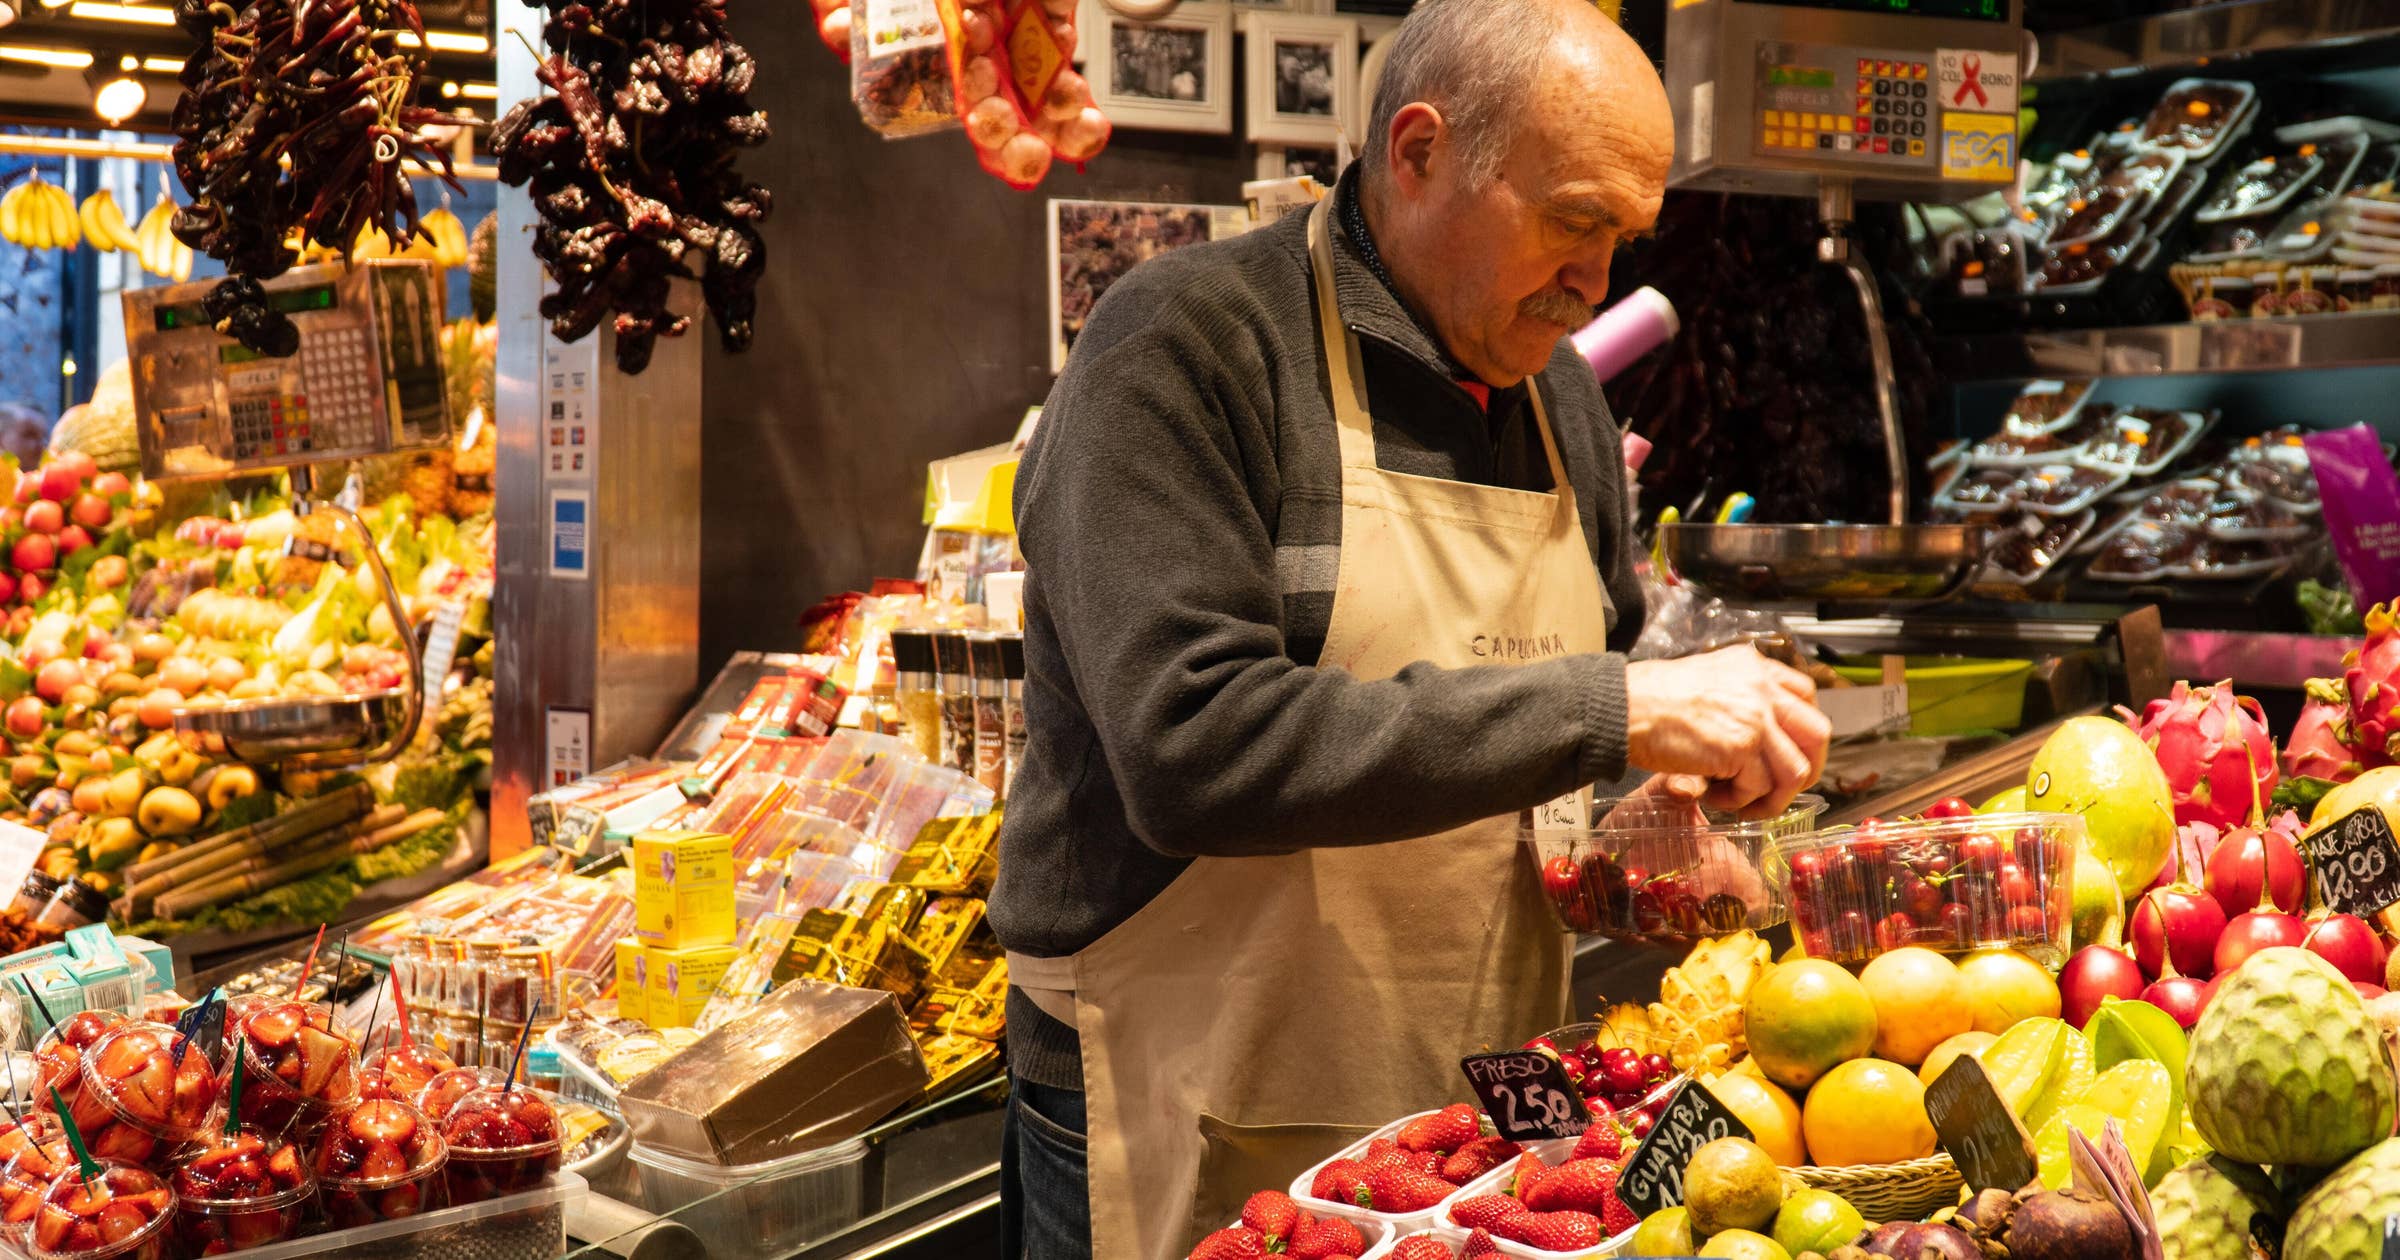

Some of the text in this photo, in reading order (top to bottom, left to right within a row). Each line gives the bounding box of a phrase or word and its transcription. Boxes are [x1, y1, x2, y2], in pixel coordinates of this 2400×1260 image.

[1941, 56, 1956, 68] YO
[1467, 1056, 1550, 1082] FRESO
[1493, 1084, 1571, 1133] 2,50
[1630, 1088, 1710, 1201] GUAYABA
